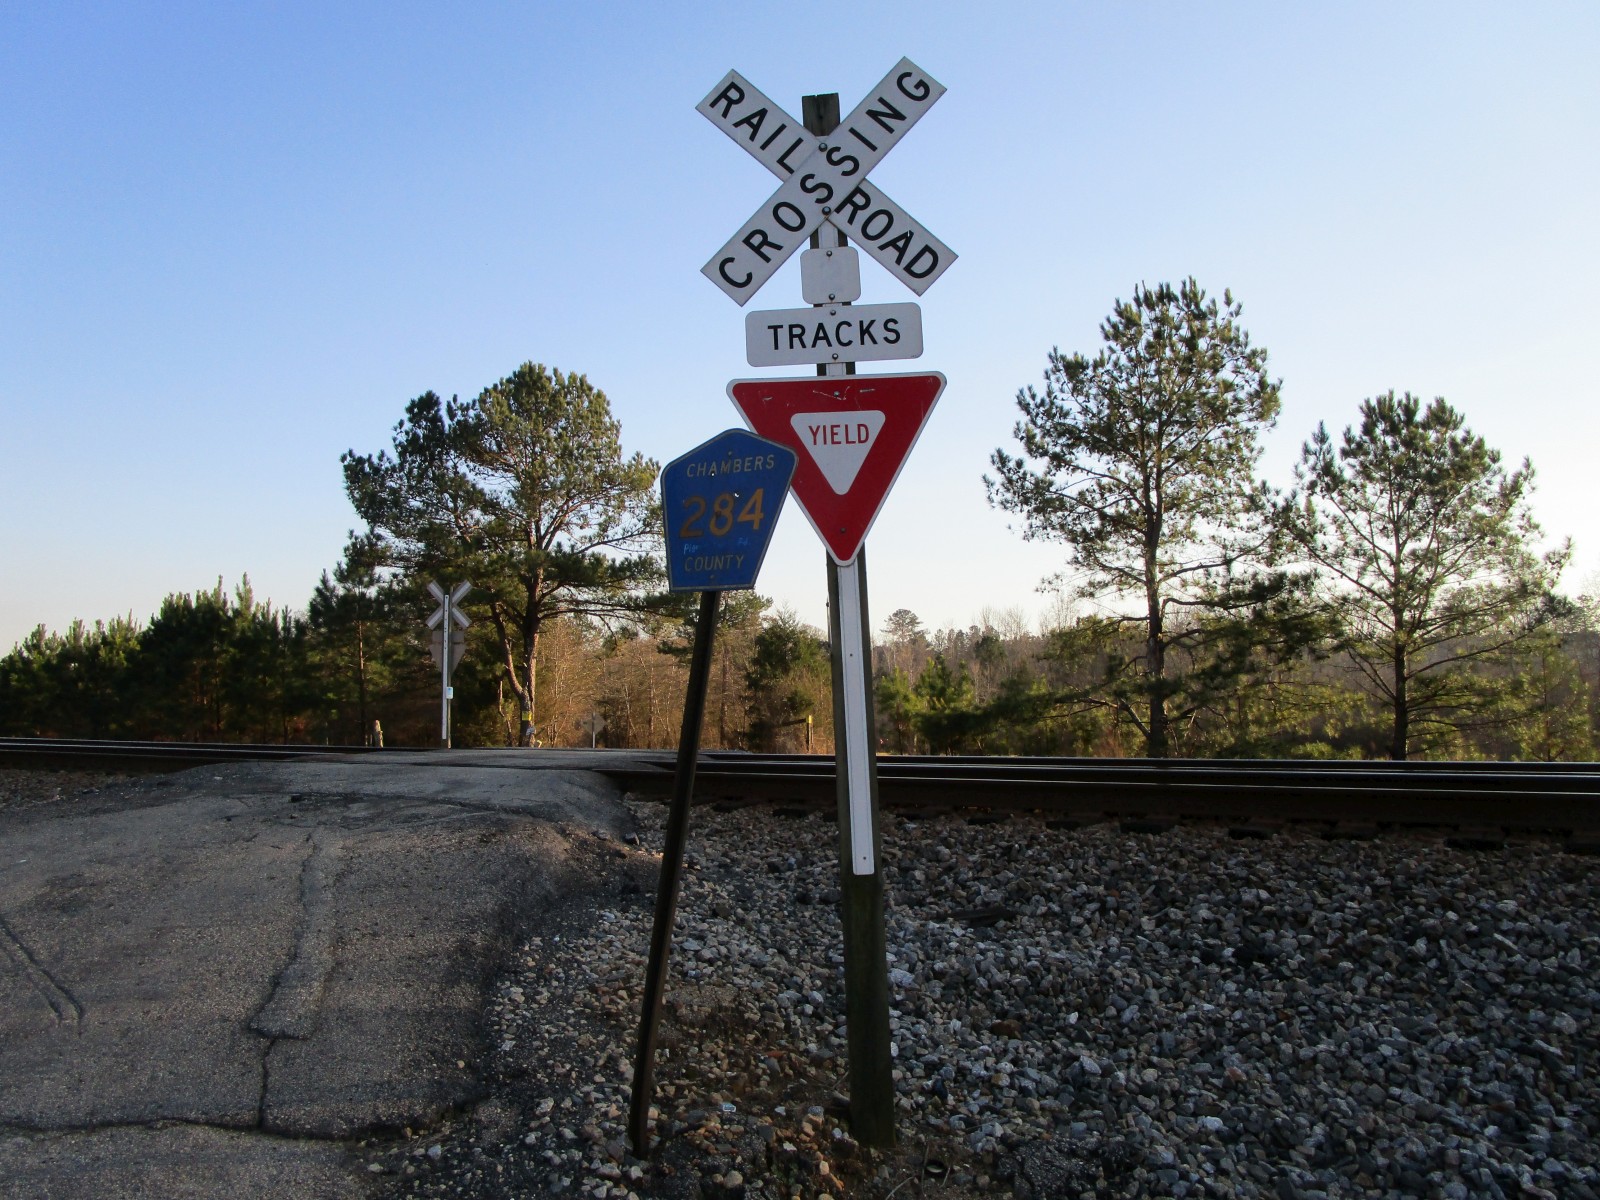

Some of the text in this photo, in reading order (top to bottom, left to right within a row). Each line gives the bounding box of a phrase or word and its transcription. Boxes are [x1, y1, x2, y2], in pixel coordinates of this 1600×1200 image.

[709, 81, 939, 279] RAIL ROAD
[718, 71, 931, 289] CROSSING
[767, 317, 901, 350] TRACKS
[808, 423, 870, 446] YIELD
[686, 454, 775, 478] CHAMBERS
[679, 488, 764, 538] 284
[684, 554, 744, 572] COUNTY
